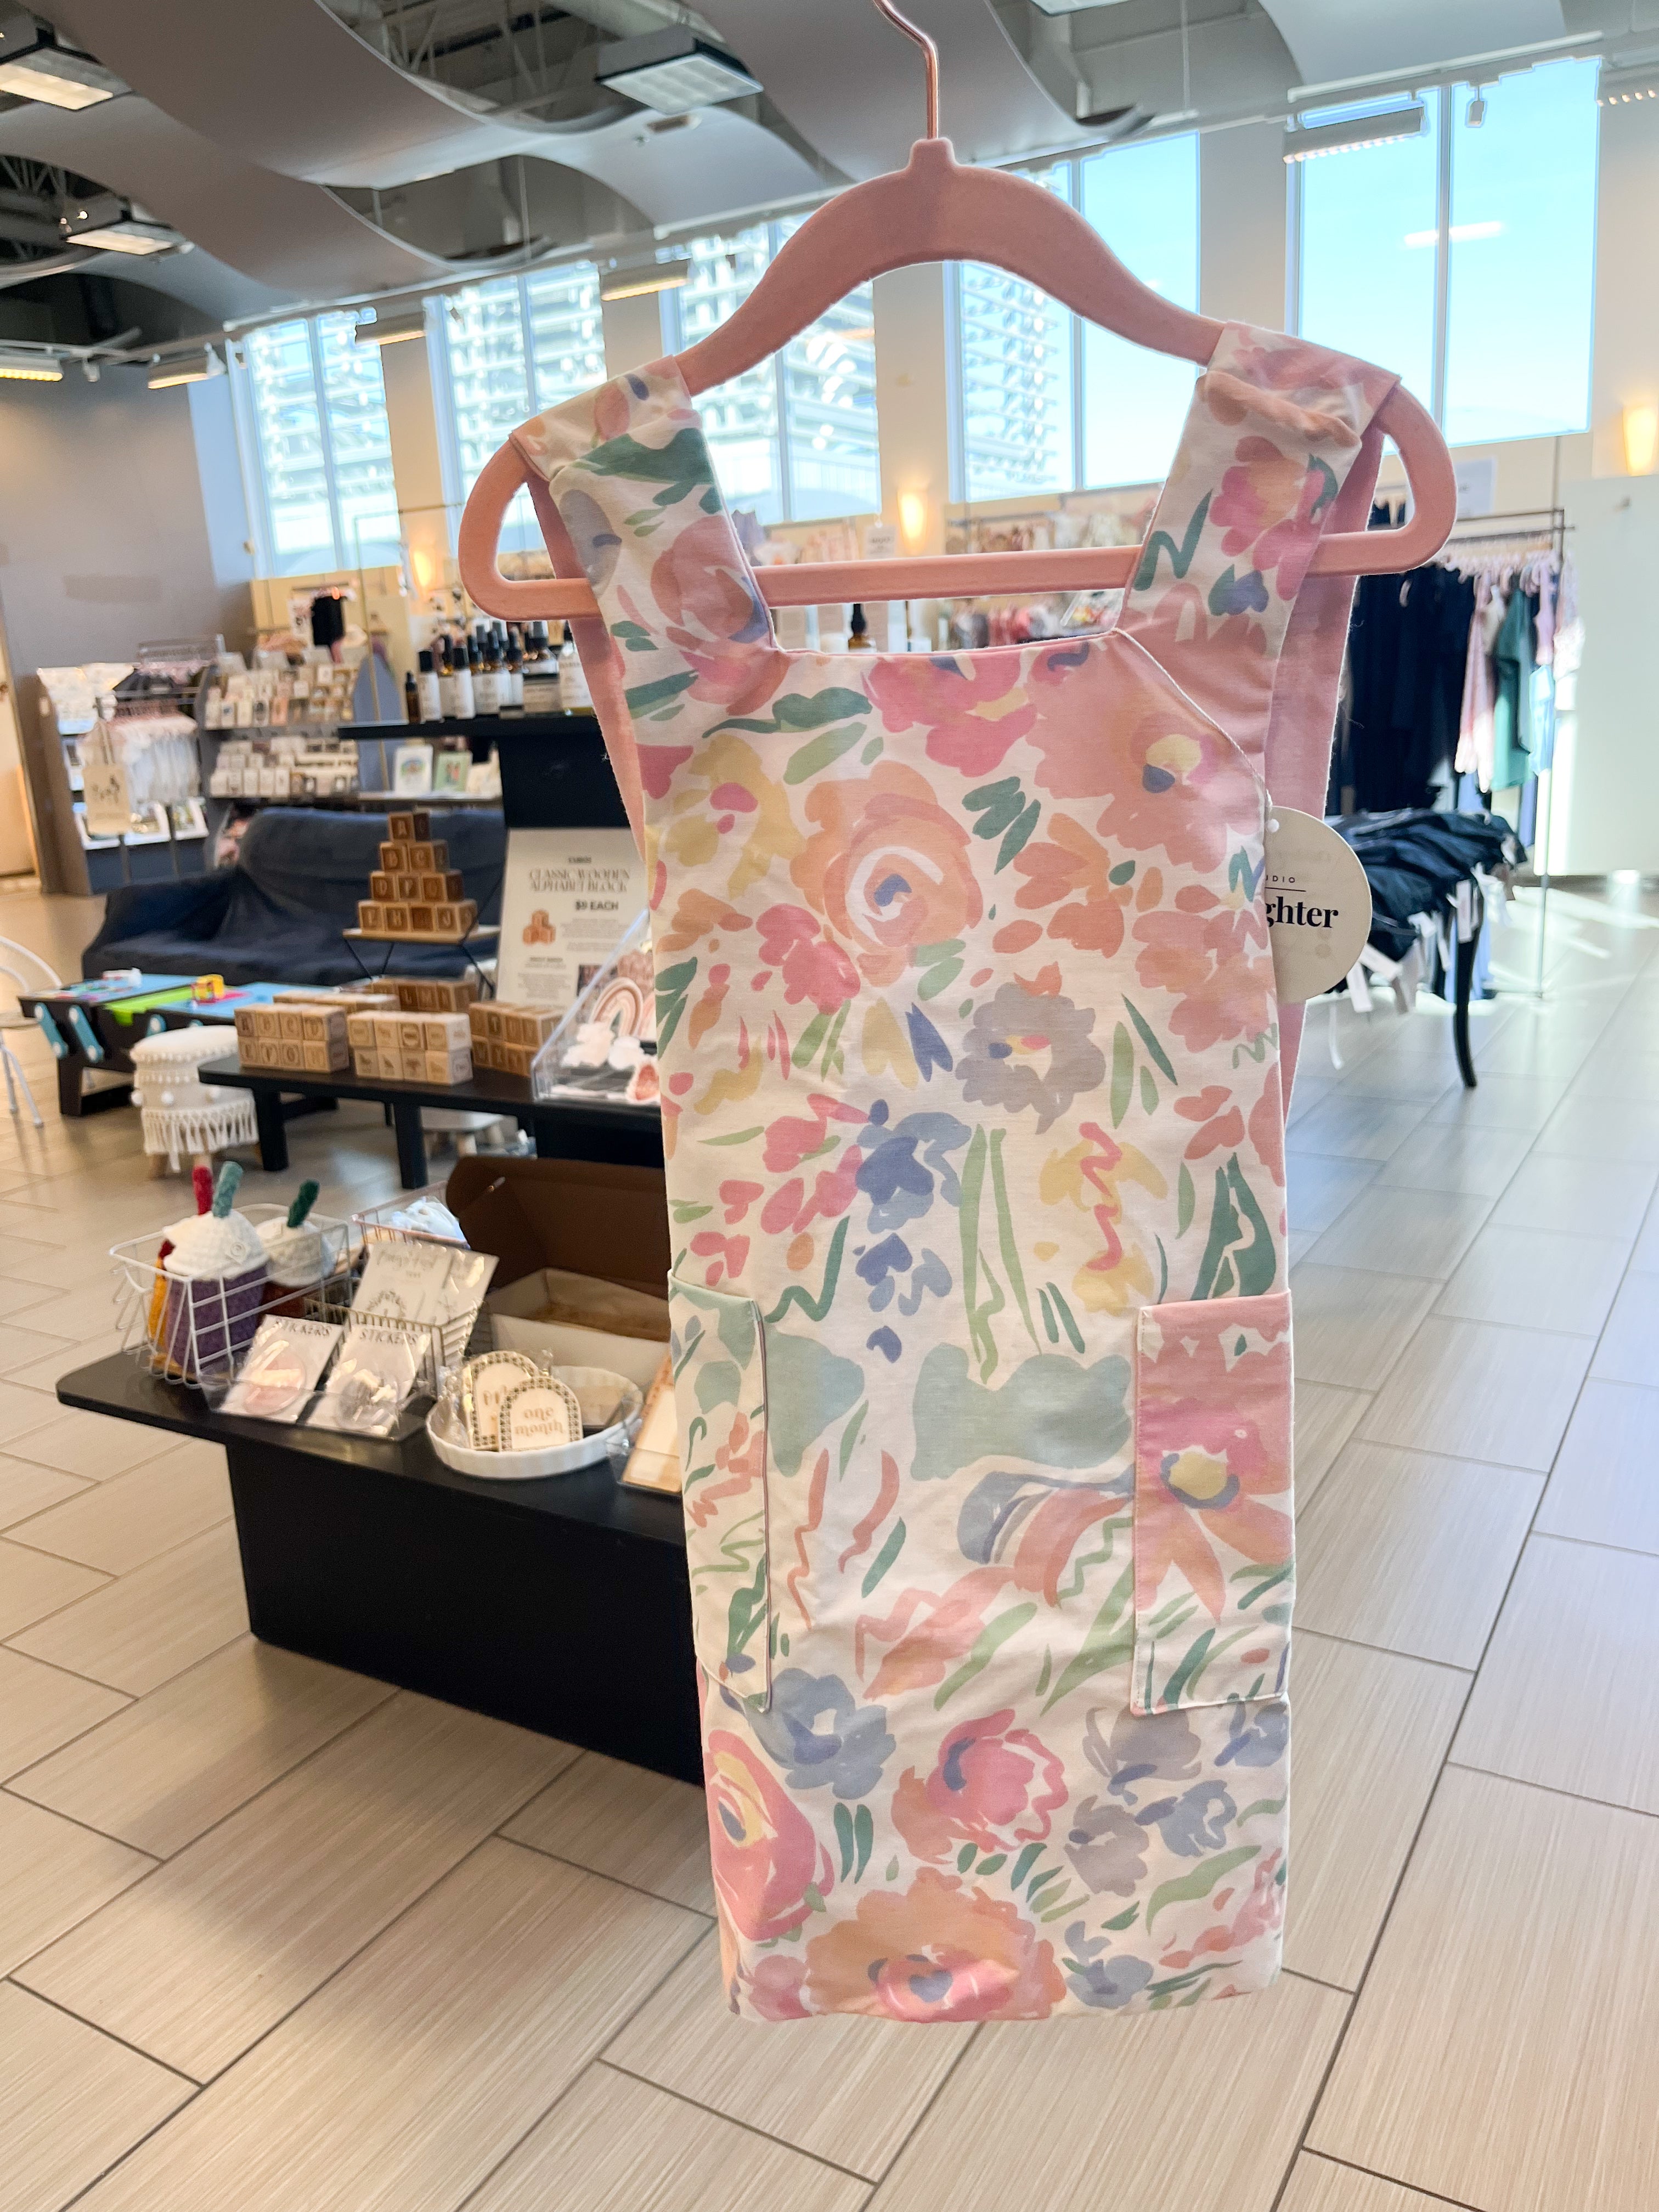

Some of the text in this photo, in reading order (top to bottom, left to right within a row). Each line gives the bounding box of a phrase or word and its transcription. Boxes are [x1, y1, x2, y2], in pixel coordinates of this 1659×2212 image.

[529, 868, 630, 880] CLASSIC WOODEN
[530, 879, 585, 892] ALPHABET
[590, 900, 619, 911] EACH
[524, 1407, 554, 1421] one
